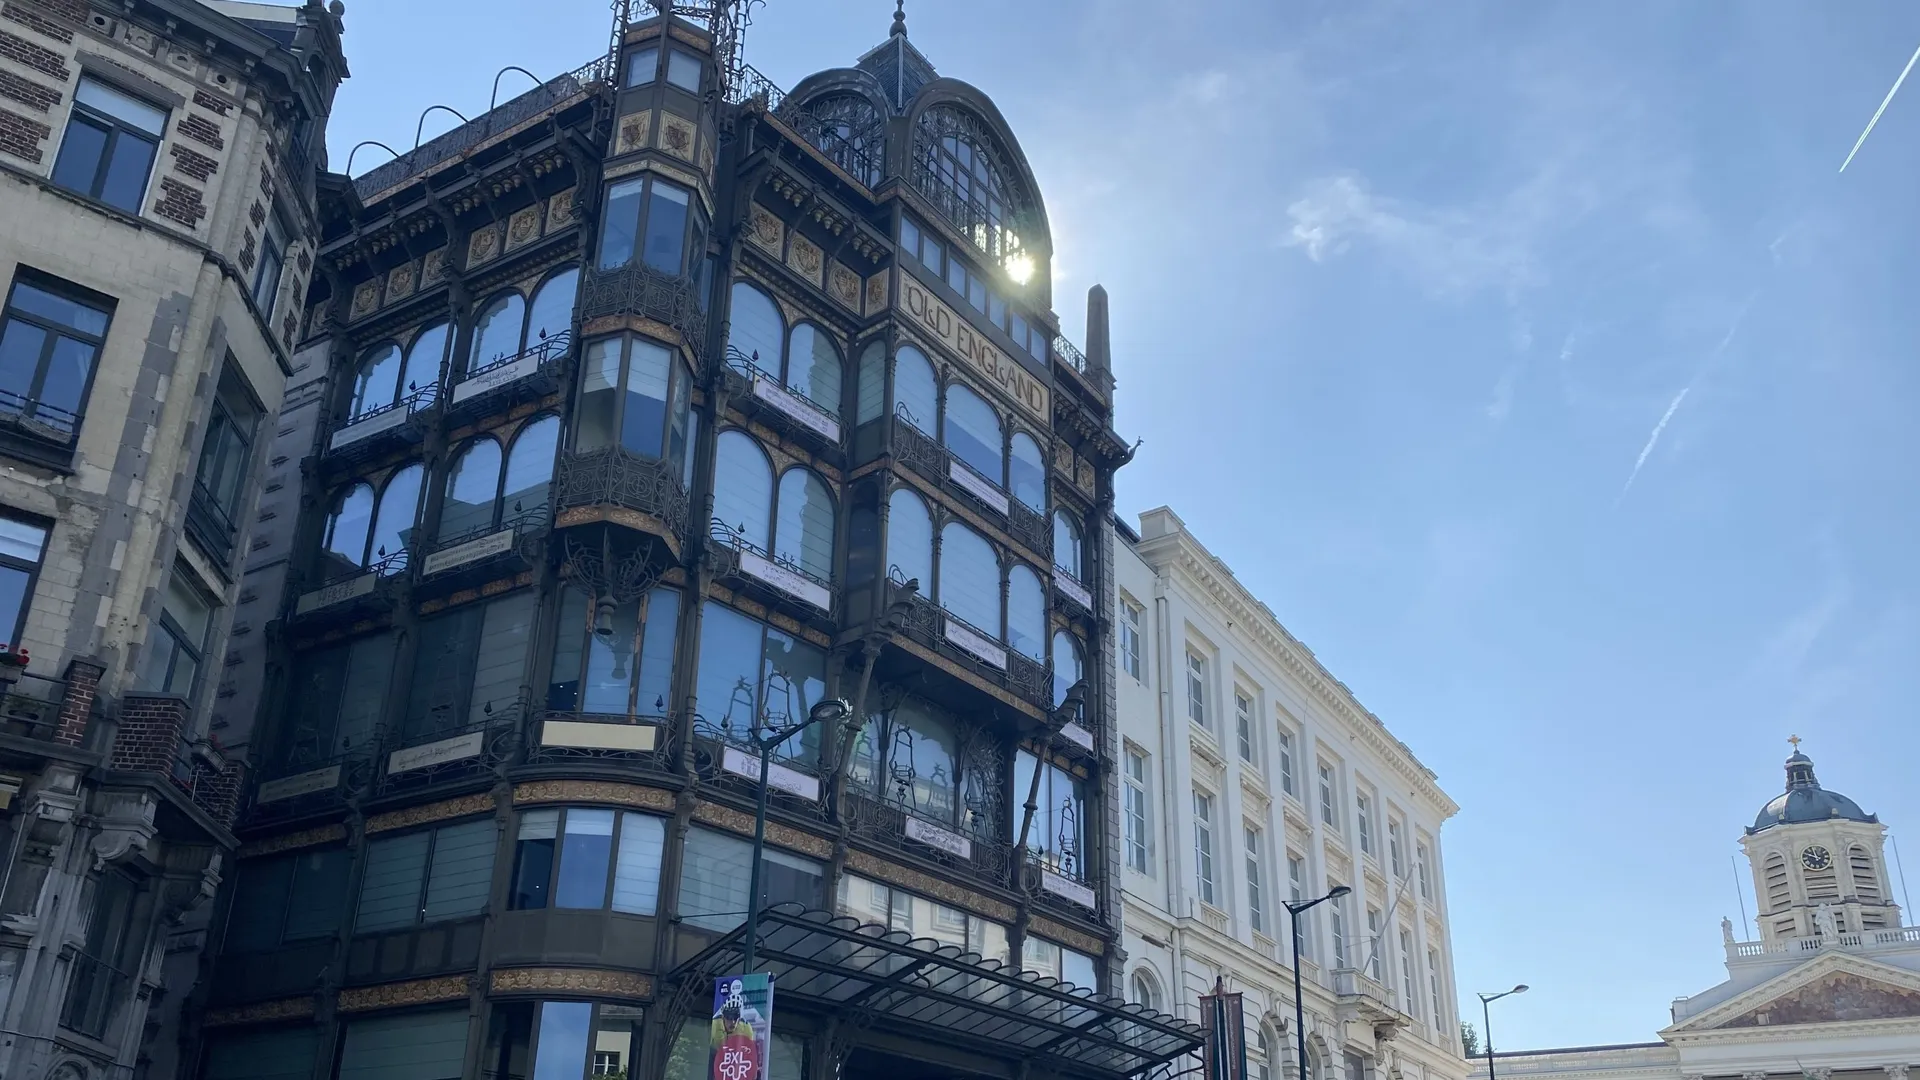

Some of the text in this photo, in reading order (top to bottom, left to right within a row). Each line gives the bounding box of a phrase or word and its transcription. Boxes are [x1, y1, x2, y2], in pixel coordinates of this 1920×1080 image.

[907, 286, 1043, 413] OLD ENGLAND
[723, 1052, 751, 1065] BXL
[719, 1062, 751, 1080] TOUR
